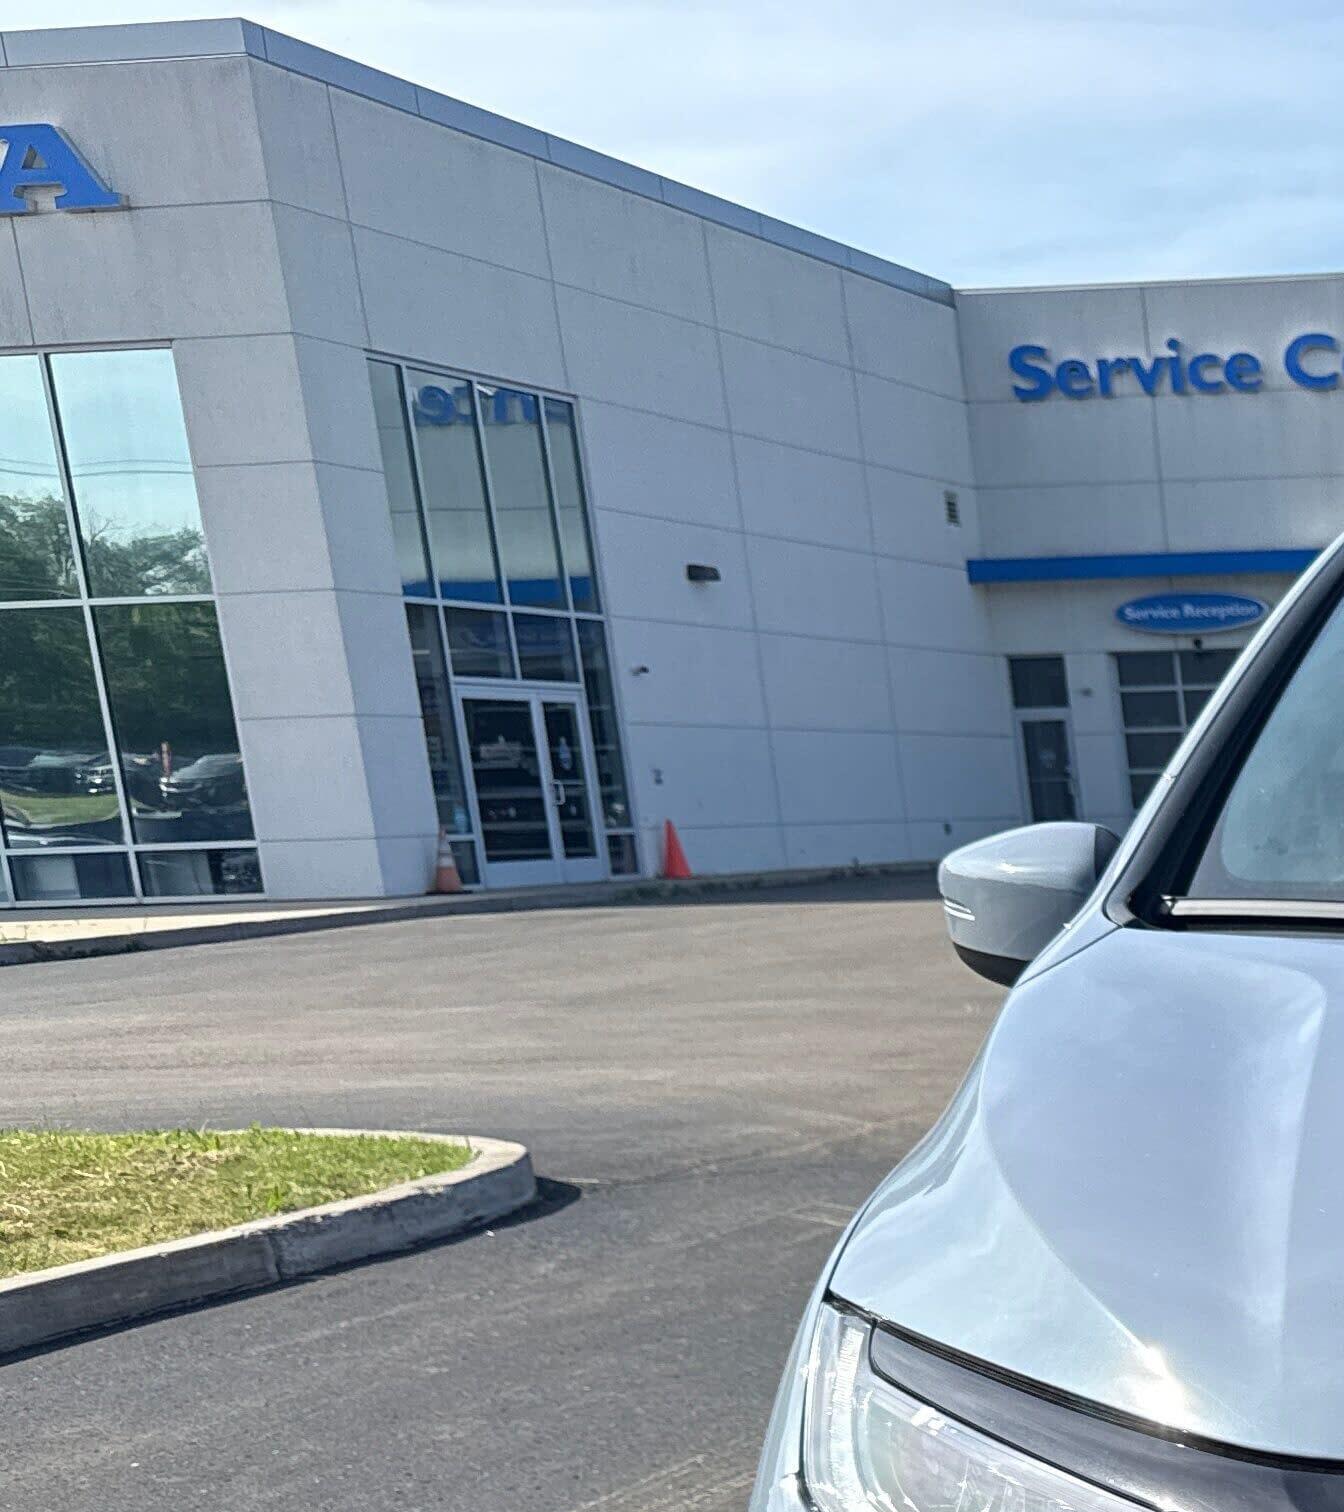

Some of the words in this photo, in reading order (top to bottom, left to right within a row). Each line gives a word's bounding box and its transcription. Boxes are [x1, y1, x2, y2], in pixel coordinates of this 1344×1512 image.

[1008, 338, 1263, 401] Service
[1124, 606, 1179, 620] Service
[1182, 603, 1259, 620] Reception
